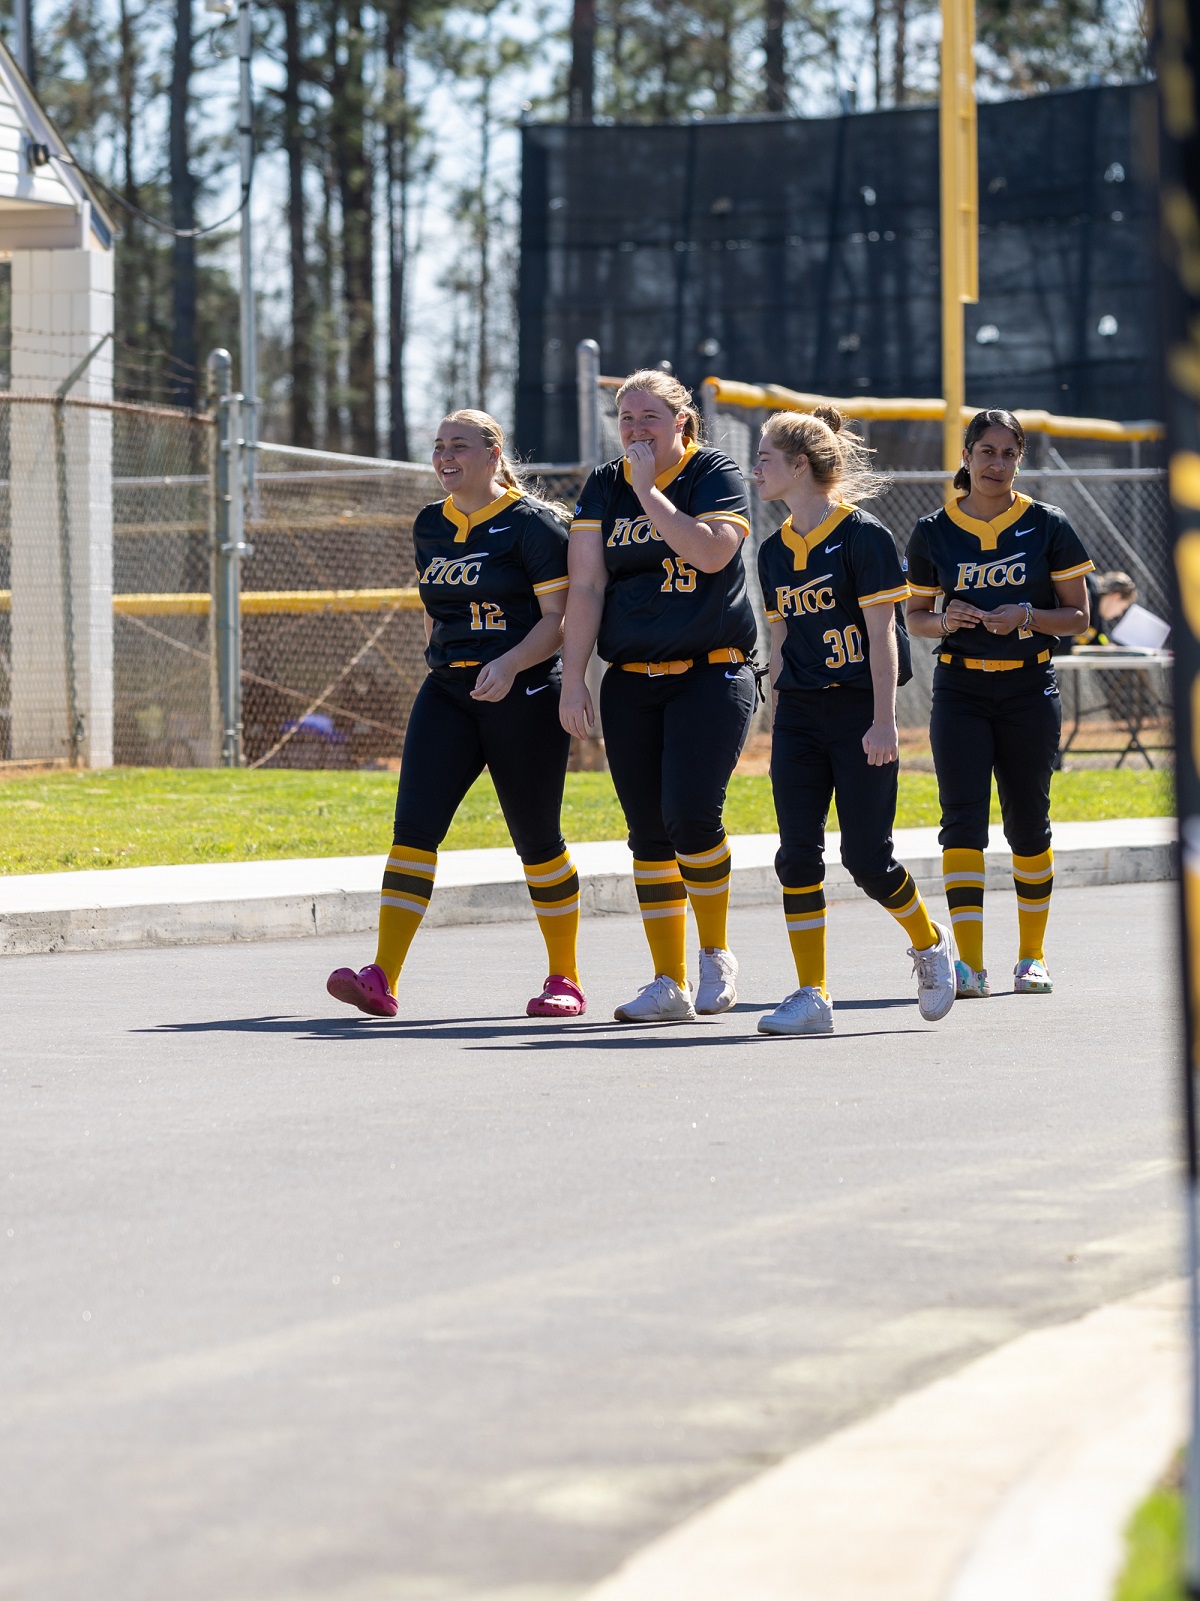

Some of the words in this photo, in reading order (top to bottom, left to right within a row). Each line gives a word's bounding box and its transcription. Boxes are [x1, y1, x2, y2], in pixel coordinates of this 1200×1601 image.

[420, 552, 489, 585] FTCC
[660, 557, 697, 593] 15
[954, 552, 1026, 591] FTCC
[775, 573, 836, 618] FTCC
[469, 601, 506, 631] 12
[822, 624, 865, 669] 30
